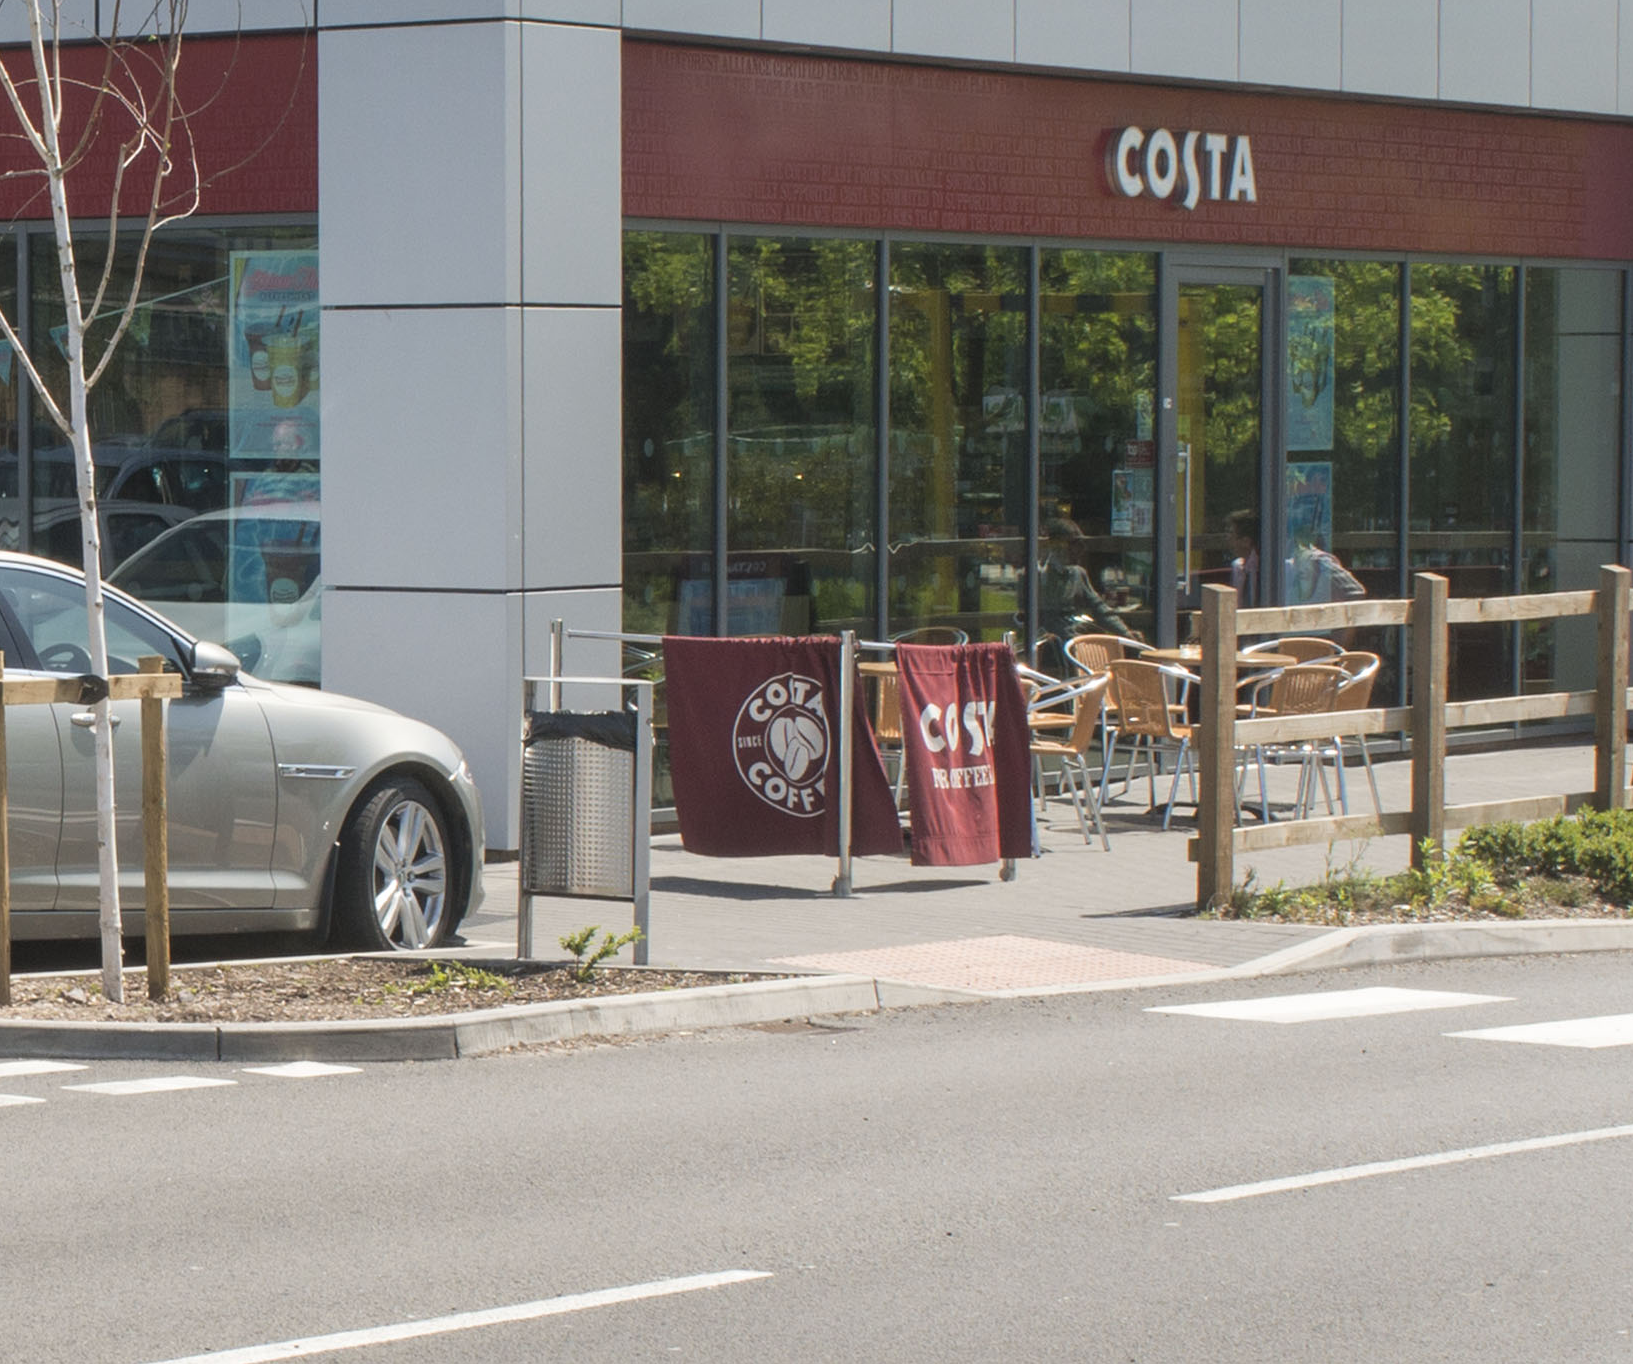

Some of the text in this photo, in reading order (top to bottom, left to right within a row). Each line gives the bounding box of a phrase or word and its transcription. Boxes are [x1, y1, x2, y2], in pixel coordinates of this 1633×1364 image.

[1115, 125, 1258, 211] COSTA
[738, 735, 762, 749] SINCE
[748, 761, 825, 812] COFF
